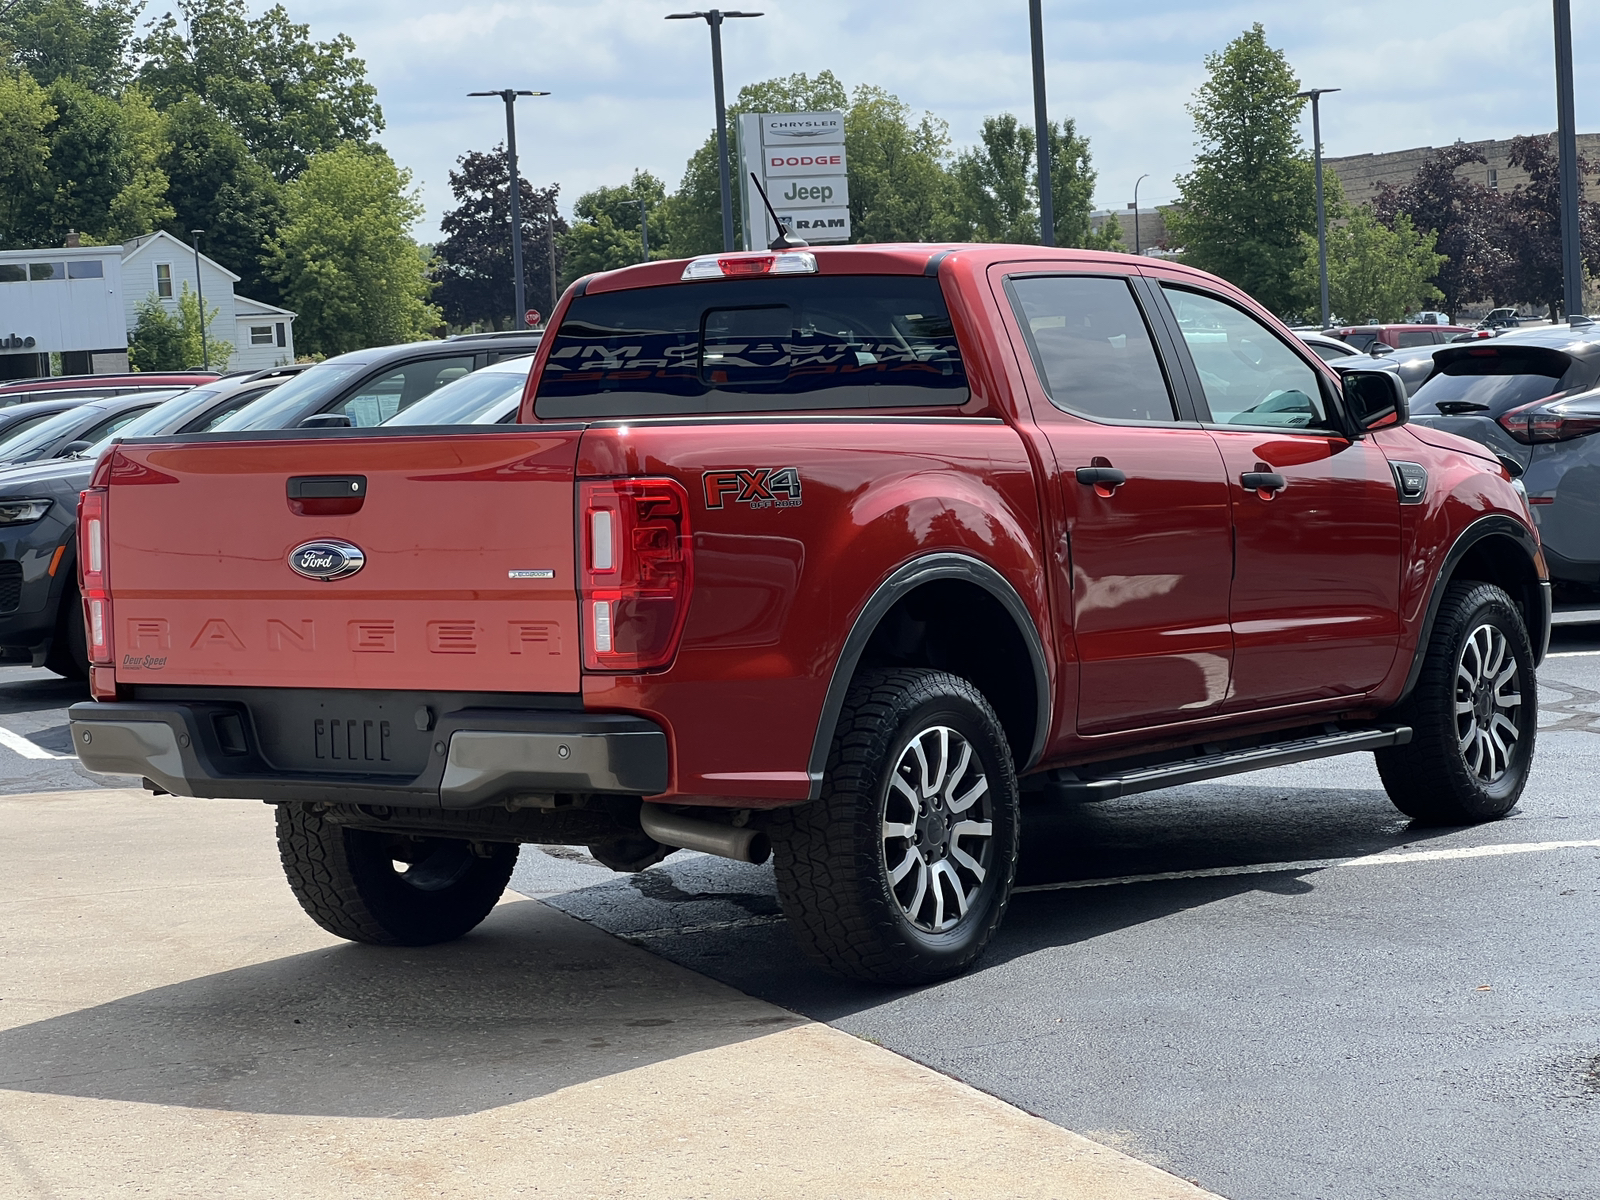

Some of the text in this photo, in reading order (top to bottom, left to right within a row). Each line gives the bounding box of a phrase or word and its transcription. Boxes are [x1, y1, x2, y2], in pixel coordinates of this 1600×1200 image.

[770, 120, 837, 128] CHRYSLER
[771, 155, 841, 167] DODGE
[784, 182, 833, 203] Jeep
[796, 218, 845, 229] RAM
[702, 467, 802, 510] FX4
[750, 500, 802, 509] OFF ROAD
[301, 550, 333, 568] Ford
[126, 617, 562, 656] RANGER
[123, 654, 143, 665] Deur
